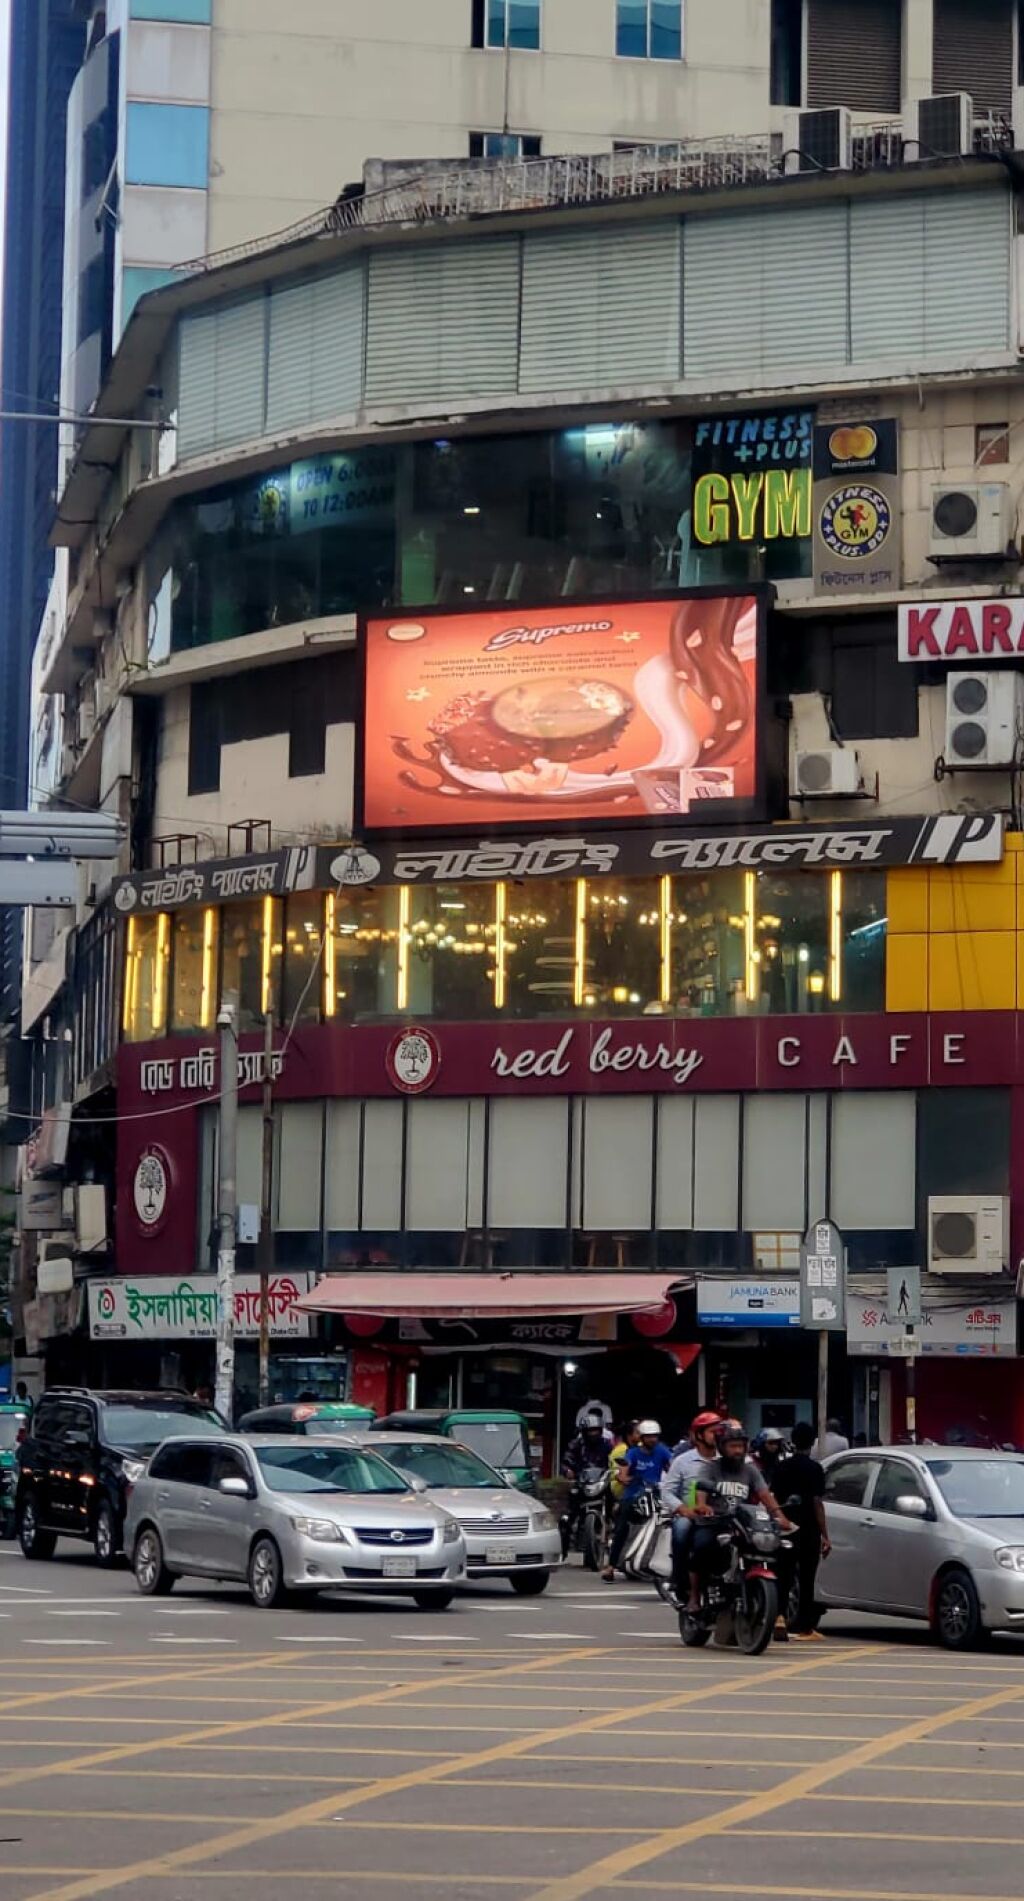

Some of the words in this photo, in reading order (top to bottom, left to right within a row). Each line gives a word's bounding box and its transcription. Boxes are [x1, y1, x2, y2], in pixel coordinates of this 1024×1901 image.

[695, 412, 812, 446] FITNESS
[694, 467, 812, 545] GYM
[823, 487, 888, 520] FITNESS
[841, 528, 869, 540] GYM
[393, 838, 620, 879] লাইটিং
[650, 829, 893, 869] প্যালেস
[141, 870, 205, 907] লাইটিং
[211, 862, 280, 897] প্যালেস
[141, 1058, 175, 1095] রেড
[181, 1047, 217, 1091] বেরি
[491, 1027, 574, 1078] red
[589, 1027, 703, 1084] berry
[125, 1282, 217, 1330] ইসলামিয়া
[730, 1286, 769, 1298] JAMUNA
[770, 1286, 798, 1297] BANK
